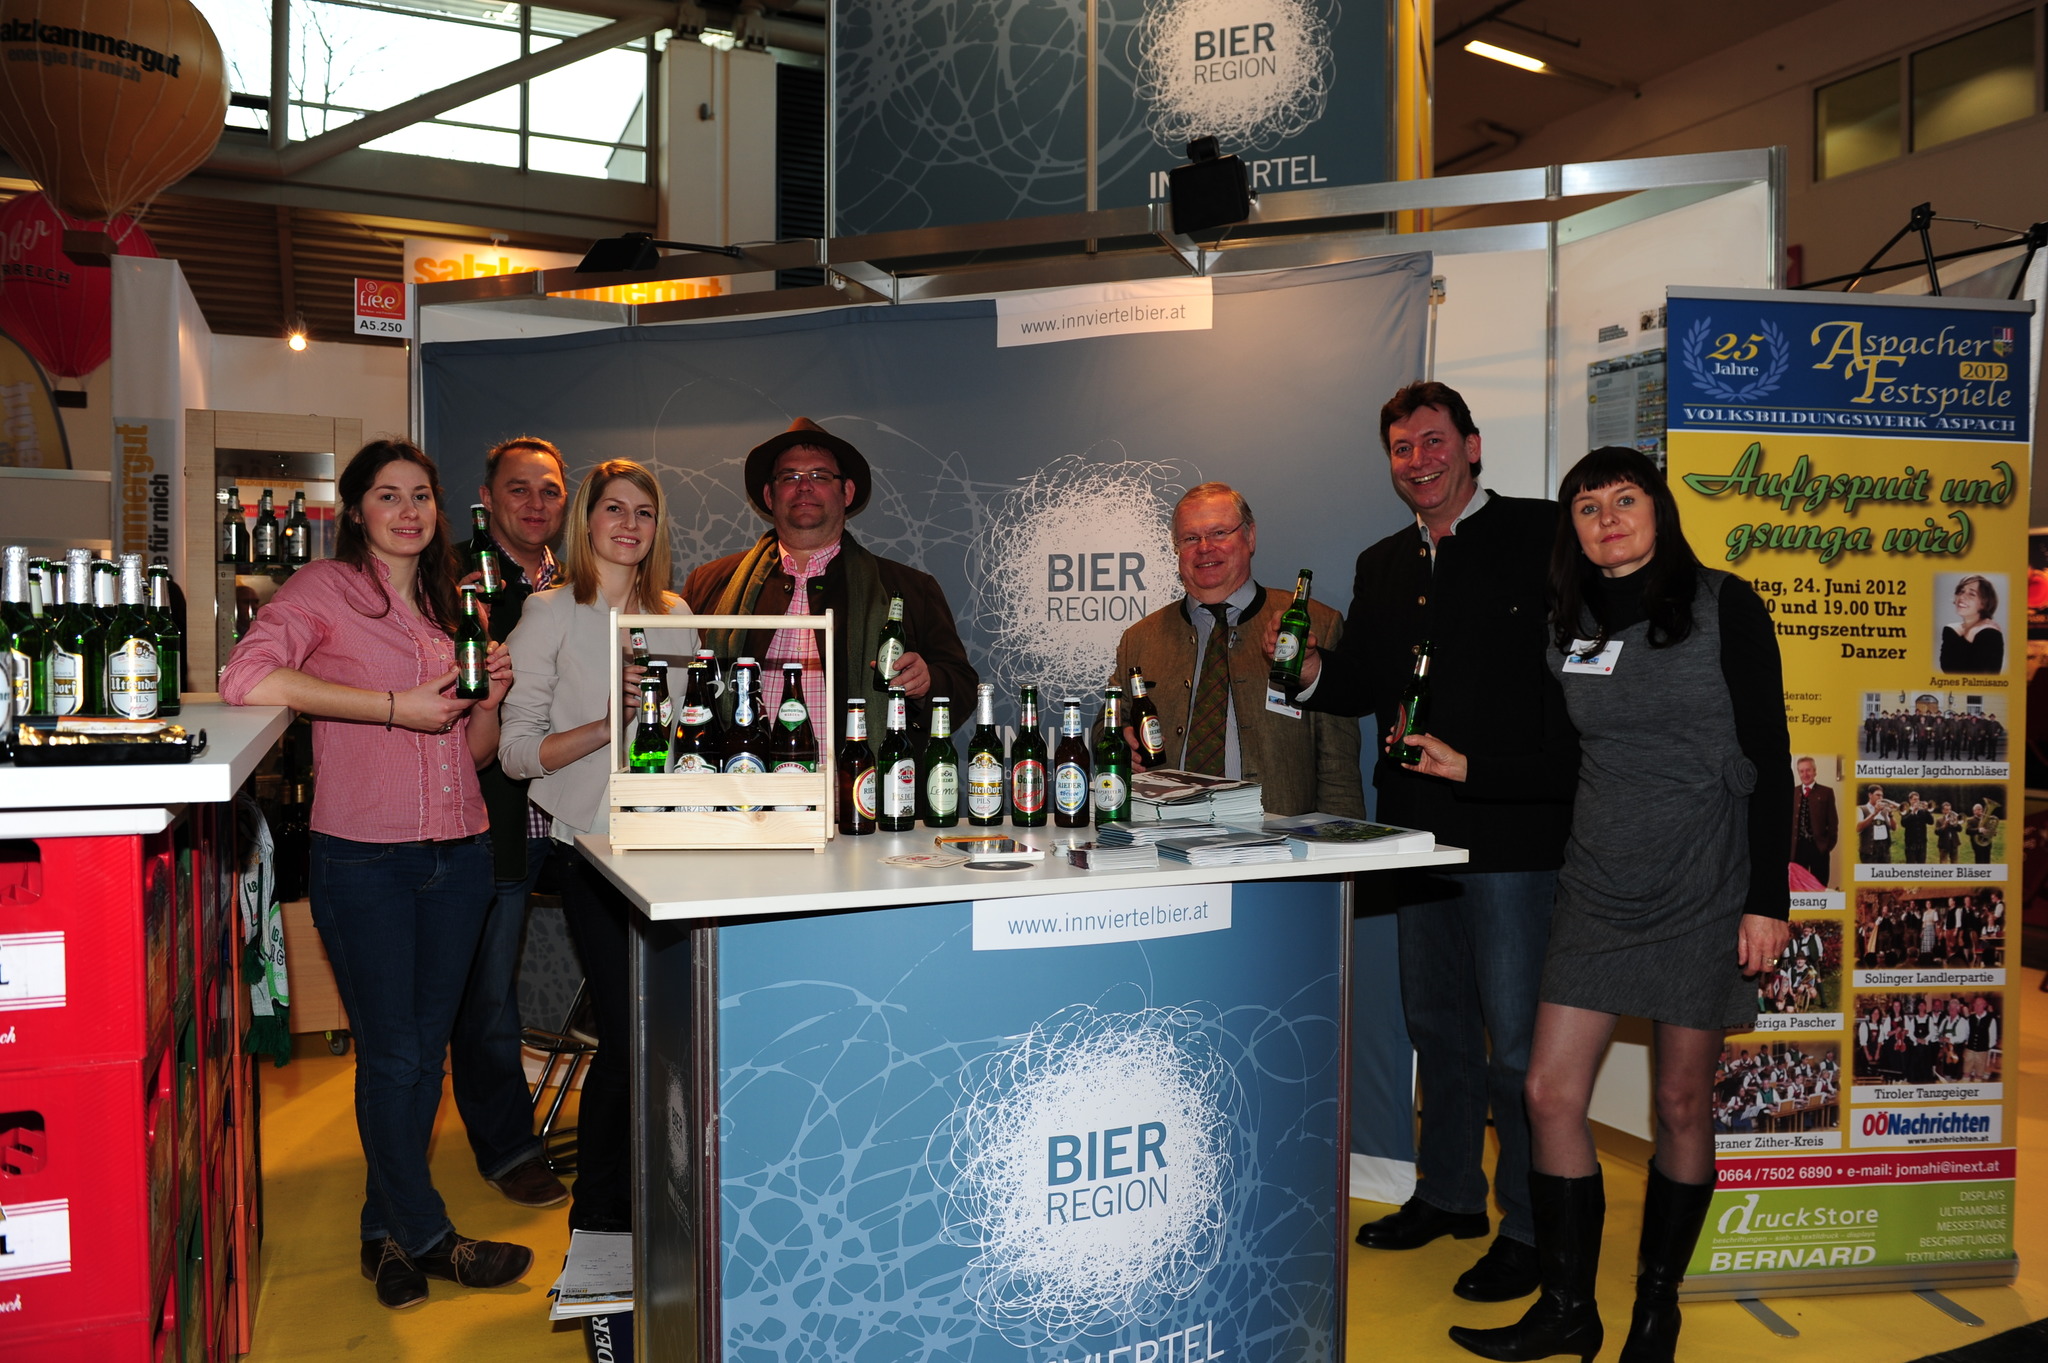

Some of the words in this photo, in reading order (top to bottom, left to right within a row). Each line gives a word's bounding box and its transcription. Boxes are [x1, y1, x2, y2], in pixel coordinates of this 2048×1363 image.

[1195, 22, 1277, 61] BIER
[9, 48, 67, 66] energie
[71, 52, 97, 71] für
[98, 59, 142, 83] mich
[1194, 56, 1277, 85] REGION
[360, 320, 403, 333] A5.250
[1021, 304, 1186, 335] www.innviertelbier.at
[1705, 333, 1768, 361] 25
[1811, 321, 1991, 370] Aspacher
[1711, 363, 1759, 377] Jahre
[1962, 363, 2006, 380] 2012
[1845, 355, 2012, 418] Festspiele
[1683, 408, 1927, 430] VOLKSBILDUNGSWERK
[1935, 417, 2016, 432] ASPACH
[1682, 441, 1929, 513] Aufgspuit
[1941, 461, 2014, 505] und
[148, 474, 169, 522] mich
[148, 525, 169, 552] für
[1725, 521, 1871, 564] gsunga
[1882, 510, 1972, 555] wird
[1048, 552, 1147, 592] BIER
[1750, 578, 1787, 597] tag,
[1794, 578, 1821, 593] 24.
[1824, 578, 1862, 597] Juni
[1866, 580, 1907, 596] 2012
[1047, 596, 1147, 622] REGION
[1781, 600, 1818, 615] und
[1824, 600, 1869, 616] 19.00
[1874, 601, 1908, 617] Uhr
[1841, 643, 1908, 660] Danzer
[1930, 677, 1960, 688] Agnes
[1962, 677, 2009, 688] Palmisano
[1801, 714, 1832, 726] Egger
[1857, 764, 1920, 778] Mattigtaler
[1922, 764, 2009, 778] Jagdhornbläser
[1871, 867, 1953, 879] Laubensteiner
[1956, 867, 1992, 878] Bläser
[1008, 901, 1209, 936] www.innviertelbier.at
[1865, 972, 1914, 986] Solinger
[1916, 971, 1995, 985] Landlerpartie
[1790, 1017, 1837, 1028] Pascher
[1874, 1087, 1914, 1099] Tiroler
[1916, 1086, 1980, 1101] Tanzgeiger
[1862, 1110, 1991, 1137] OÖNachrichten
[1755, 1136, 1824, 1148] Zither-Kreis
[1908, 1136, 1989, 1145] www.nachrichten.at
[1047, 1121, 1168, 1187] BIER
[1719, 1169, 1752, 1182] 0664
[1799, 1166, 1833, 1180] 6890
[1847, 1163, 1893, 1178] e-mail:
[1896, 1161, 2000, 1178] jomahi@inext.at
[1047, 1174, 1168, 1226] REGION
[1960, 1190, 2005, 1201] DISPLAYS
[1940, 1204, 2007, 1217] ULTRAMOBILE
[1937, 1219, 2007, 1231] MESSESTÄNDE
[1713, 1235, 1768, 1244] beschriftungen
[1919, 1234, 2006, 1247] BESCHRIFTUNGEN
[1709, 1246, 1877, 1272] BERNARD
